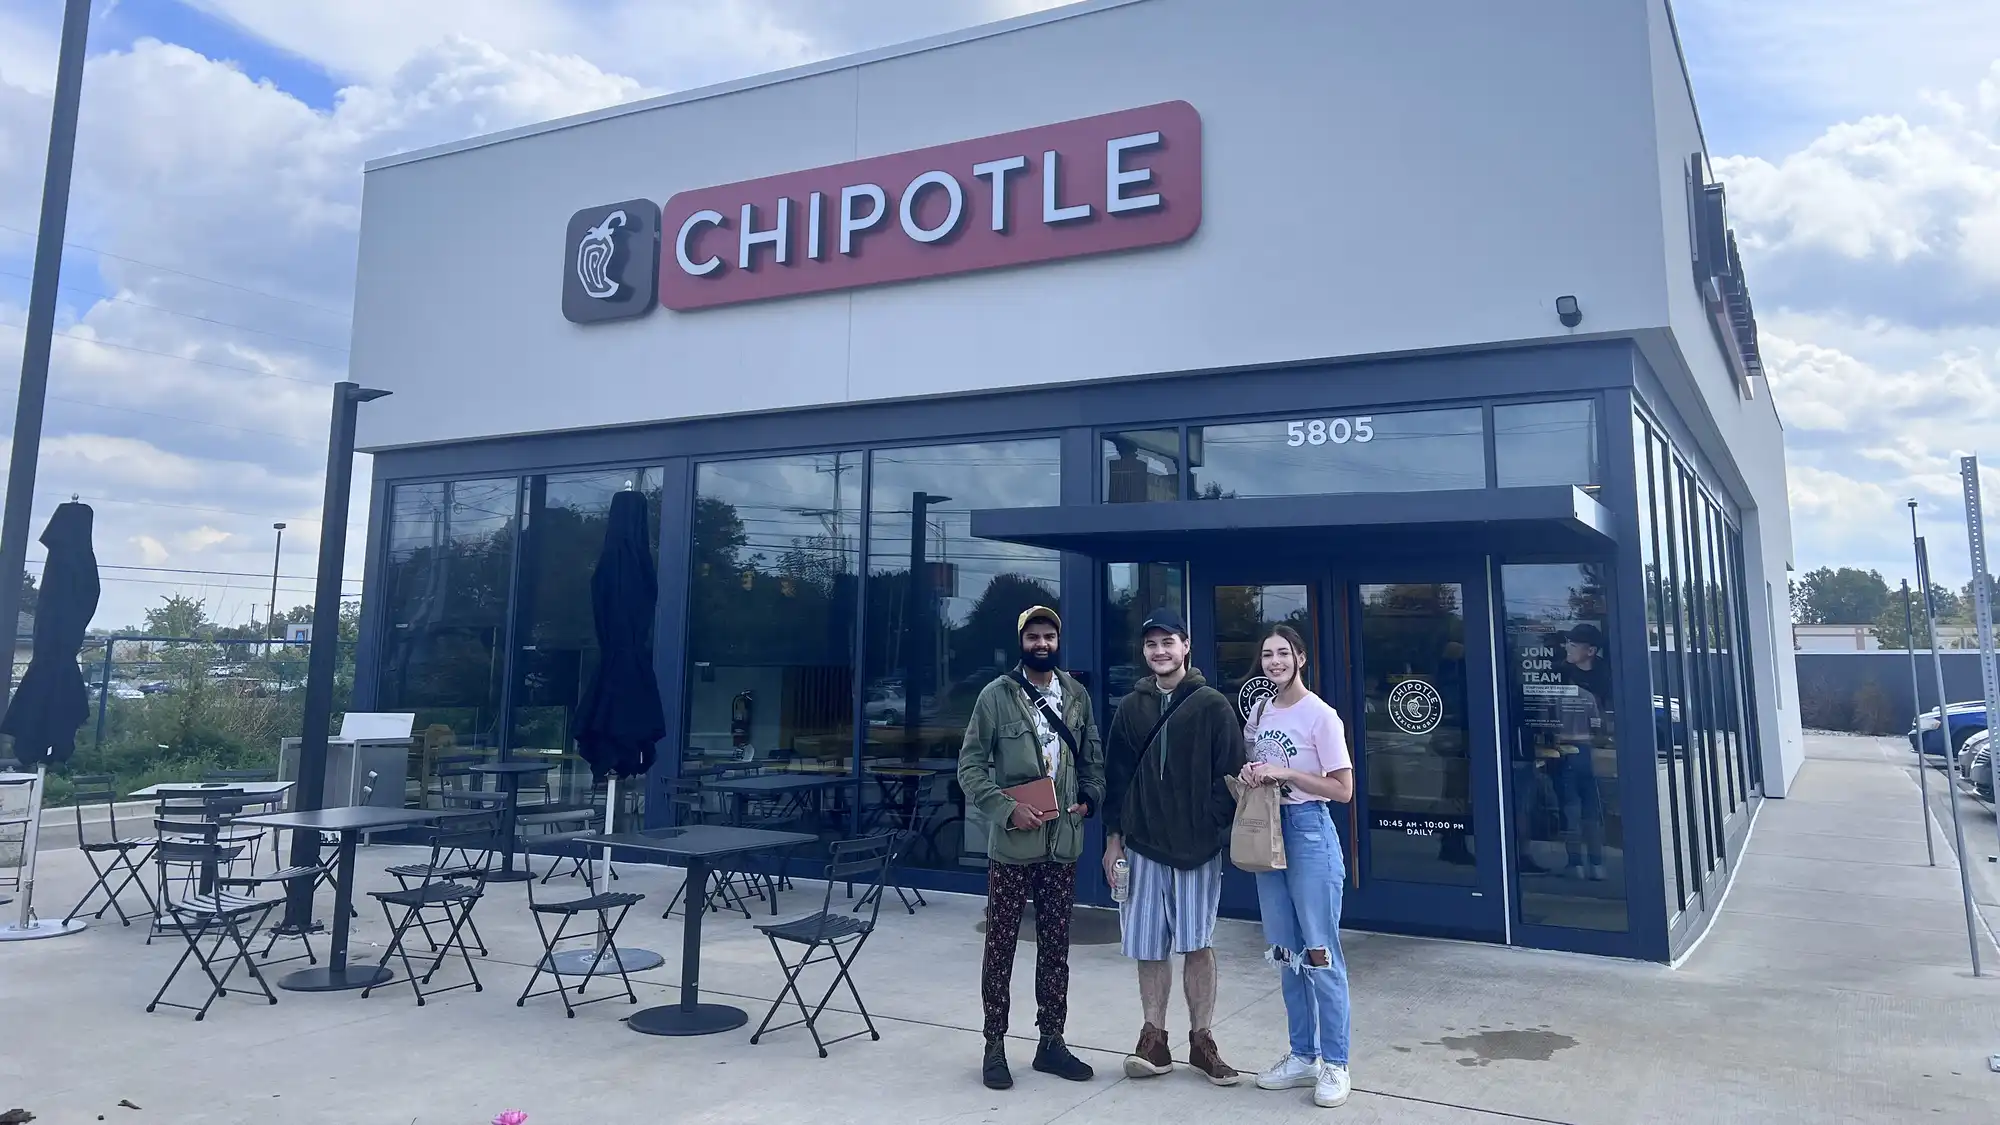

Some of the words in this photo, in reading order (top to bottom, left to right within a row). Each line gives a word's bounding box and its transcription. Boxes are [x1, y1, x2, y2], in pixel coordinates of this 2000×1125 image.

[676, 131, 1160, 275] CHIPOTLE
[1287, 417, 1374, 447] 5805
[1521, 647, 1554, 657] JOIN
[1522, 660, 1552, 670] OUR
[1522, 672, 1562, 683] TEAM
[1242, 680, 1279, 698] CHIPOTL
[1392, 683, 1438, 704] CHIPOTLE
[1394, 711, 1421, 730] MEXICAN
[1421, 712, 1438, 729] GRILL
[1379, 819, 1403, 828] 10:45
[1424, 821, 1450, 829] 10:00
[1406, 828, 1434, 836] DAILY
